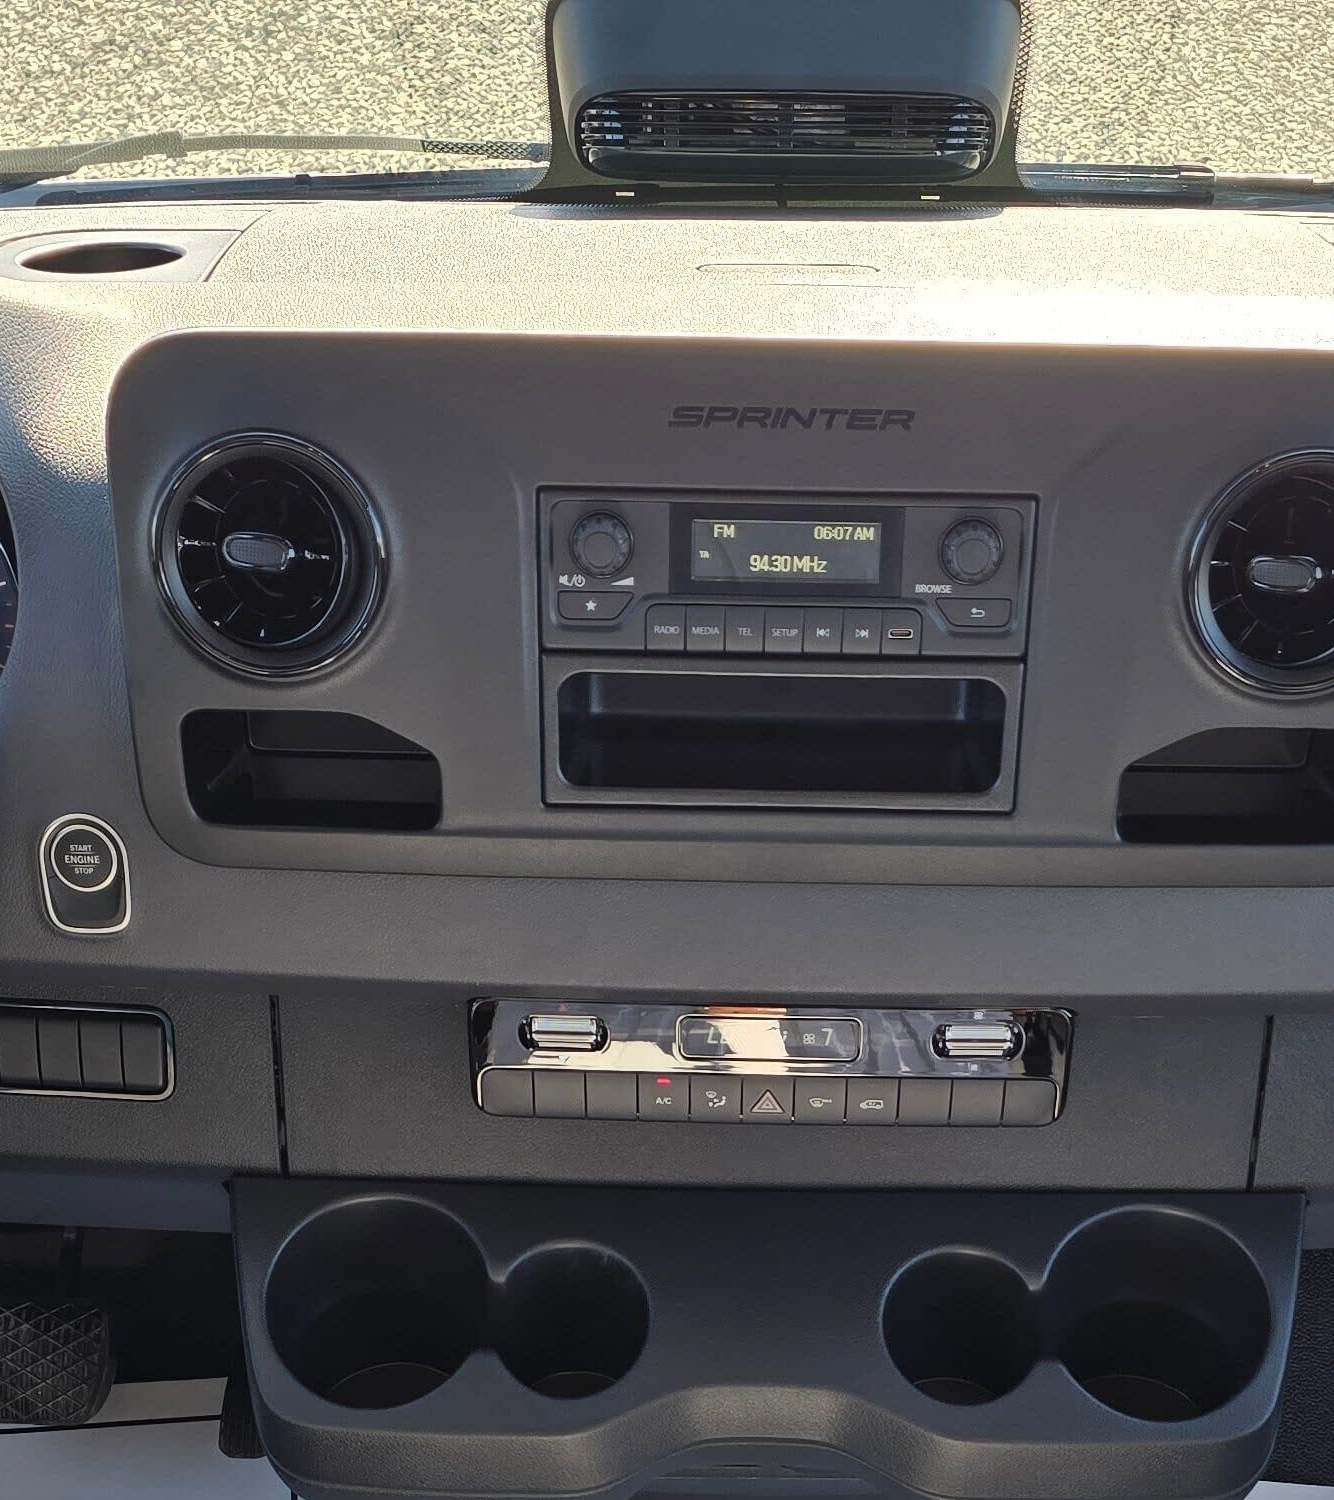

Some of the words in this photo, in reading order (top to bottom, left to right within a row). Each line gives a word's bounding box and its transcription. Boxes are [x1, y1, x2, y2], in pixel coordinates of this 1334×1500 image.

[667, 405, 916, 432] SPRINTER
[713, 524, 735, 538] FM
[814, 526, 851, 541] 06:07
[854, 527, 875, 541] AM
[793, 555, 827, 573] MHz
[915, 584, 952, 594] BROWSE
[653, 625, 680, 635] RADIO
[691, 626, 720, 636] MEDIA
[738, 627, 752, 637] TEL
[771, 628, 799, 638] SETUP
[69, 844, 92, 852] START
[64, 854, 100, 864] ENGINE
[821, 1028, 834, 1046] 7
[655, 1096, 672, 1105] A/C
